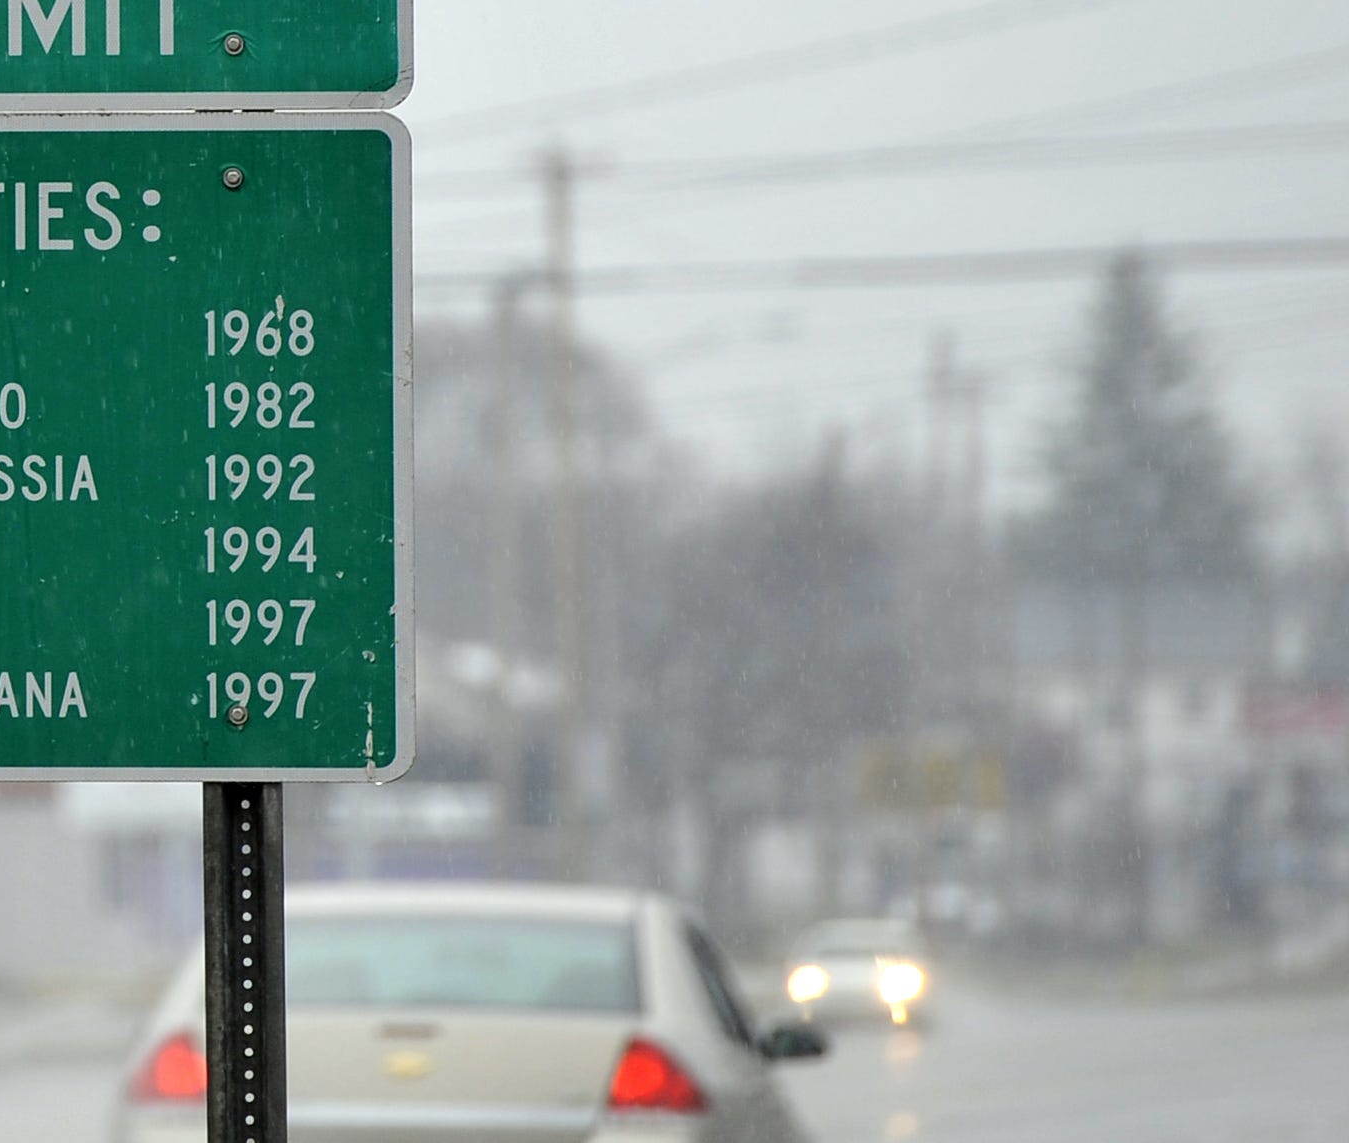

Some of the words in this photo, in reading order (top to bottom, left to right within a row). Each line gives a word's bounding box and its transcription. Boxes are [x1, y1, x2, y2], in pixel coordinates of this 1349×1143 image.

[205, 309, 315, 357] 1968
[205, 381, 315, 429] 1982
[205, 453, 316, 501] 1992
[204, 526, 317, 573] 1994
[206, 599, 316, 646] 1997
[206, 672, 316, 719] 1997
